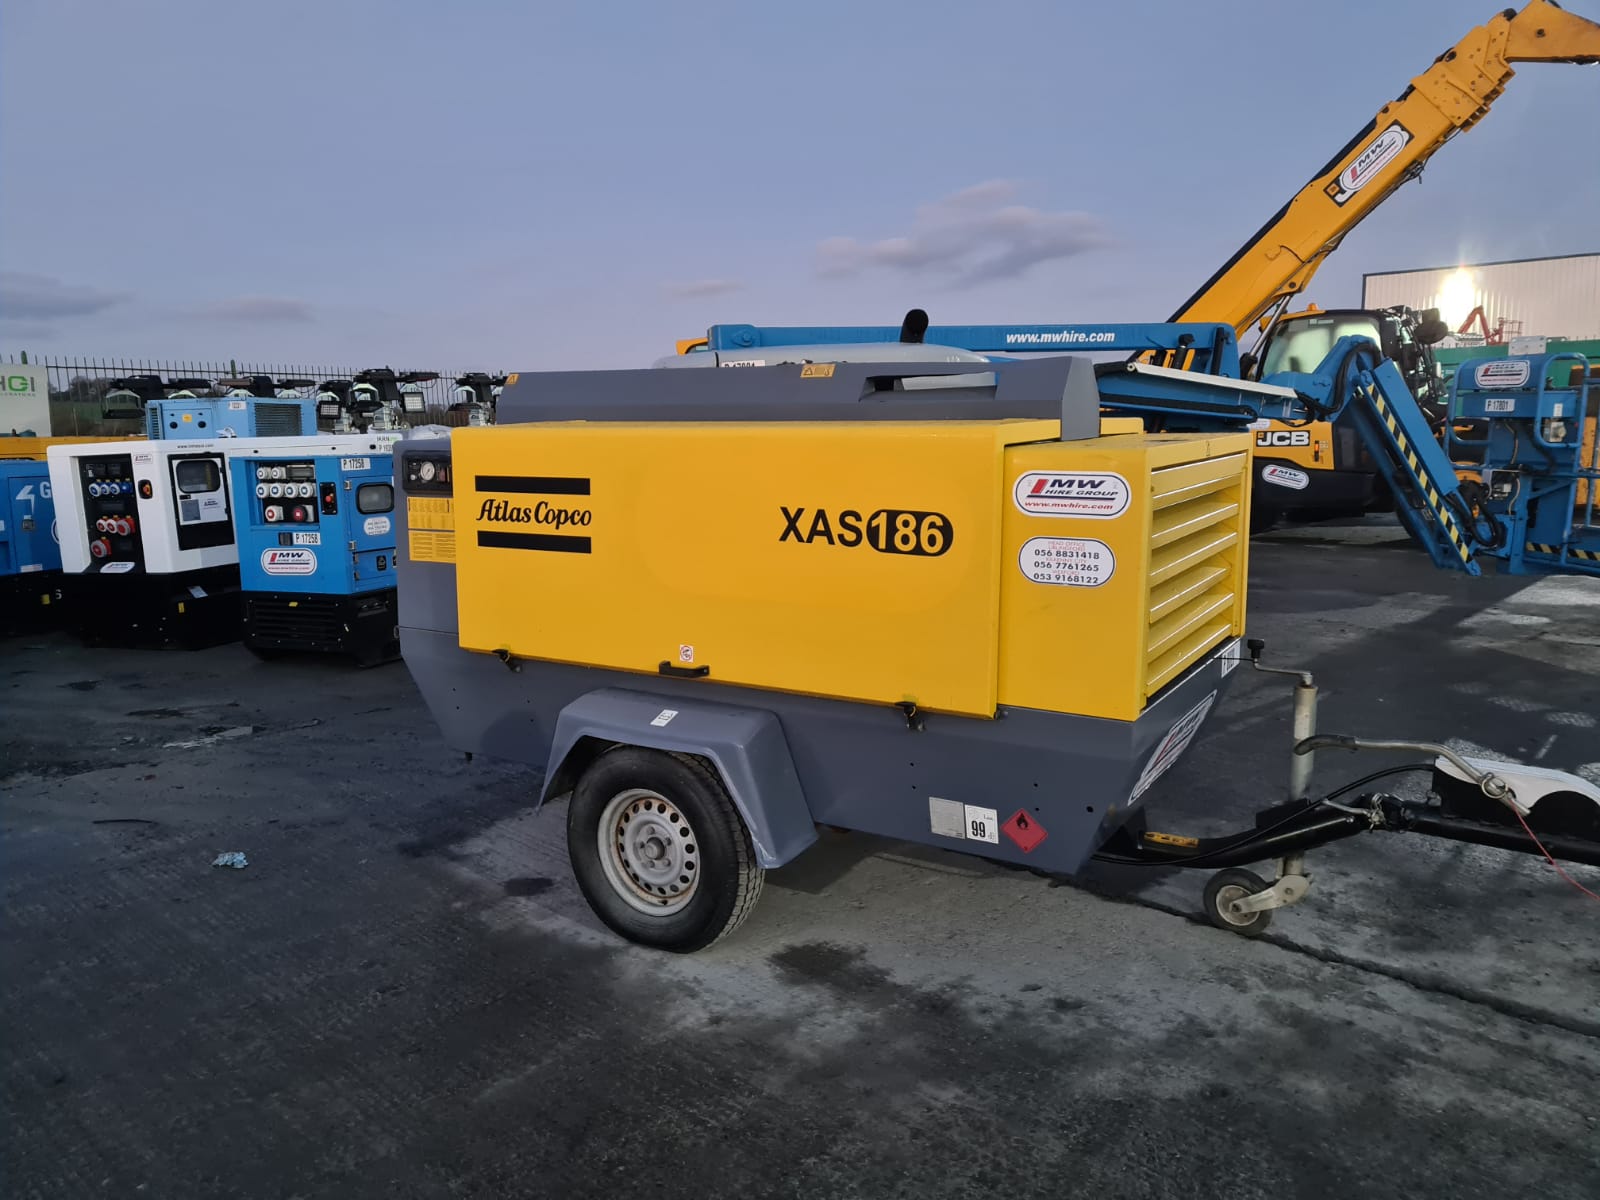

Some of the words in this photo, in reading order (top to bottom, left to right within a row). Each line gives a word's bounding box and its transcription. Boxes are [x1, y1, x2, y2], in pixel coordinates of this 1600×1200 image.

[1358, 139, 1384, 168] MW
[1006, 330, 1116, 344] www.mwhire.com
[1257, 431, 1310, 446] JCB
[1050, 479, 1105, 489] MW
[476, 498, 532, 523] Atlas
[534, 500, 592, 530] Copco
[302, 533, 318, 544] 17258
[1034, 549, 1053, 557] 056
[1055, 550, 1100, 560] 8831418
[1034, 561, 1052, 569] 056
[1055, 562, 1099, 572] 7761265
[1033, 572, 1052, 581] 053
[1054, 574, 1099, 584] 9168122
[970, 820, 986, 838] 99
